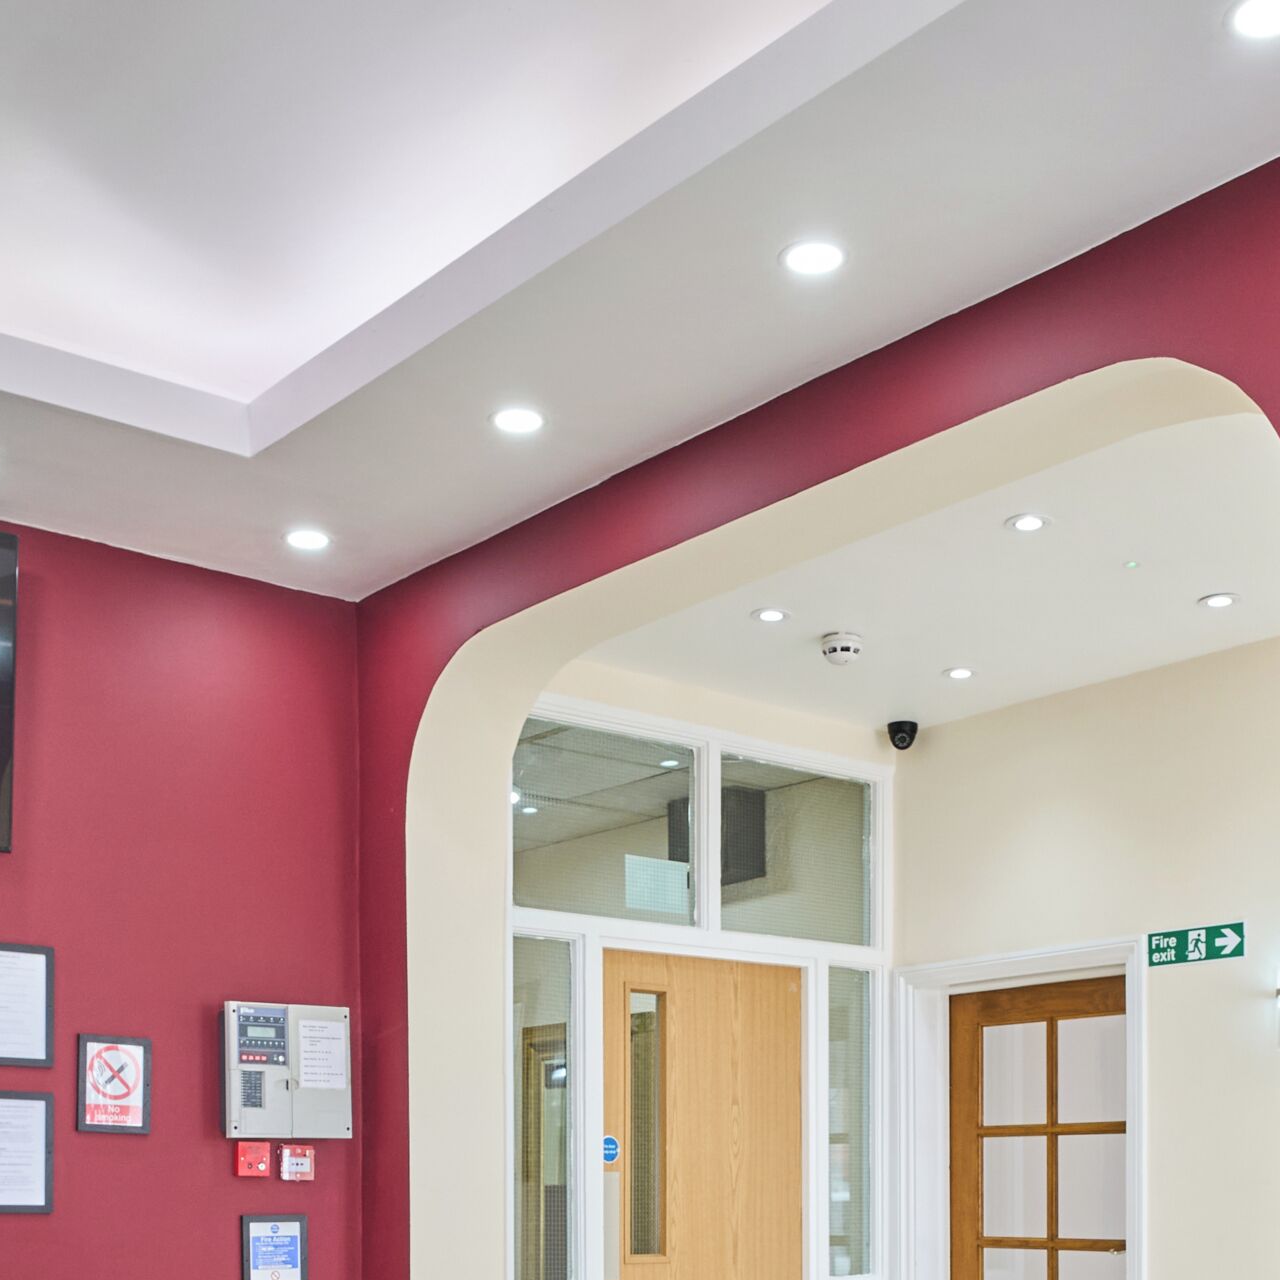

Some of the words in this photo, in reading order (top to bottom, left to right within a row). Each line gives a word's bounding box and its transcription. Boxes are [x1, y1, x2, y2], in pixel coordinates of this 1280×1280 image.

[1151, 935, 1177, 949] Fire
[1152, 948, 1176, 963] exit
[108, 1104, 120, 1113] No
